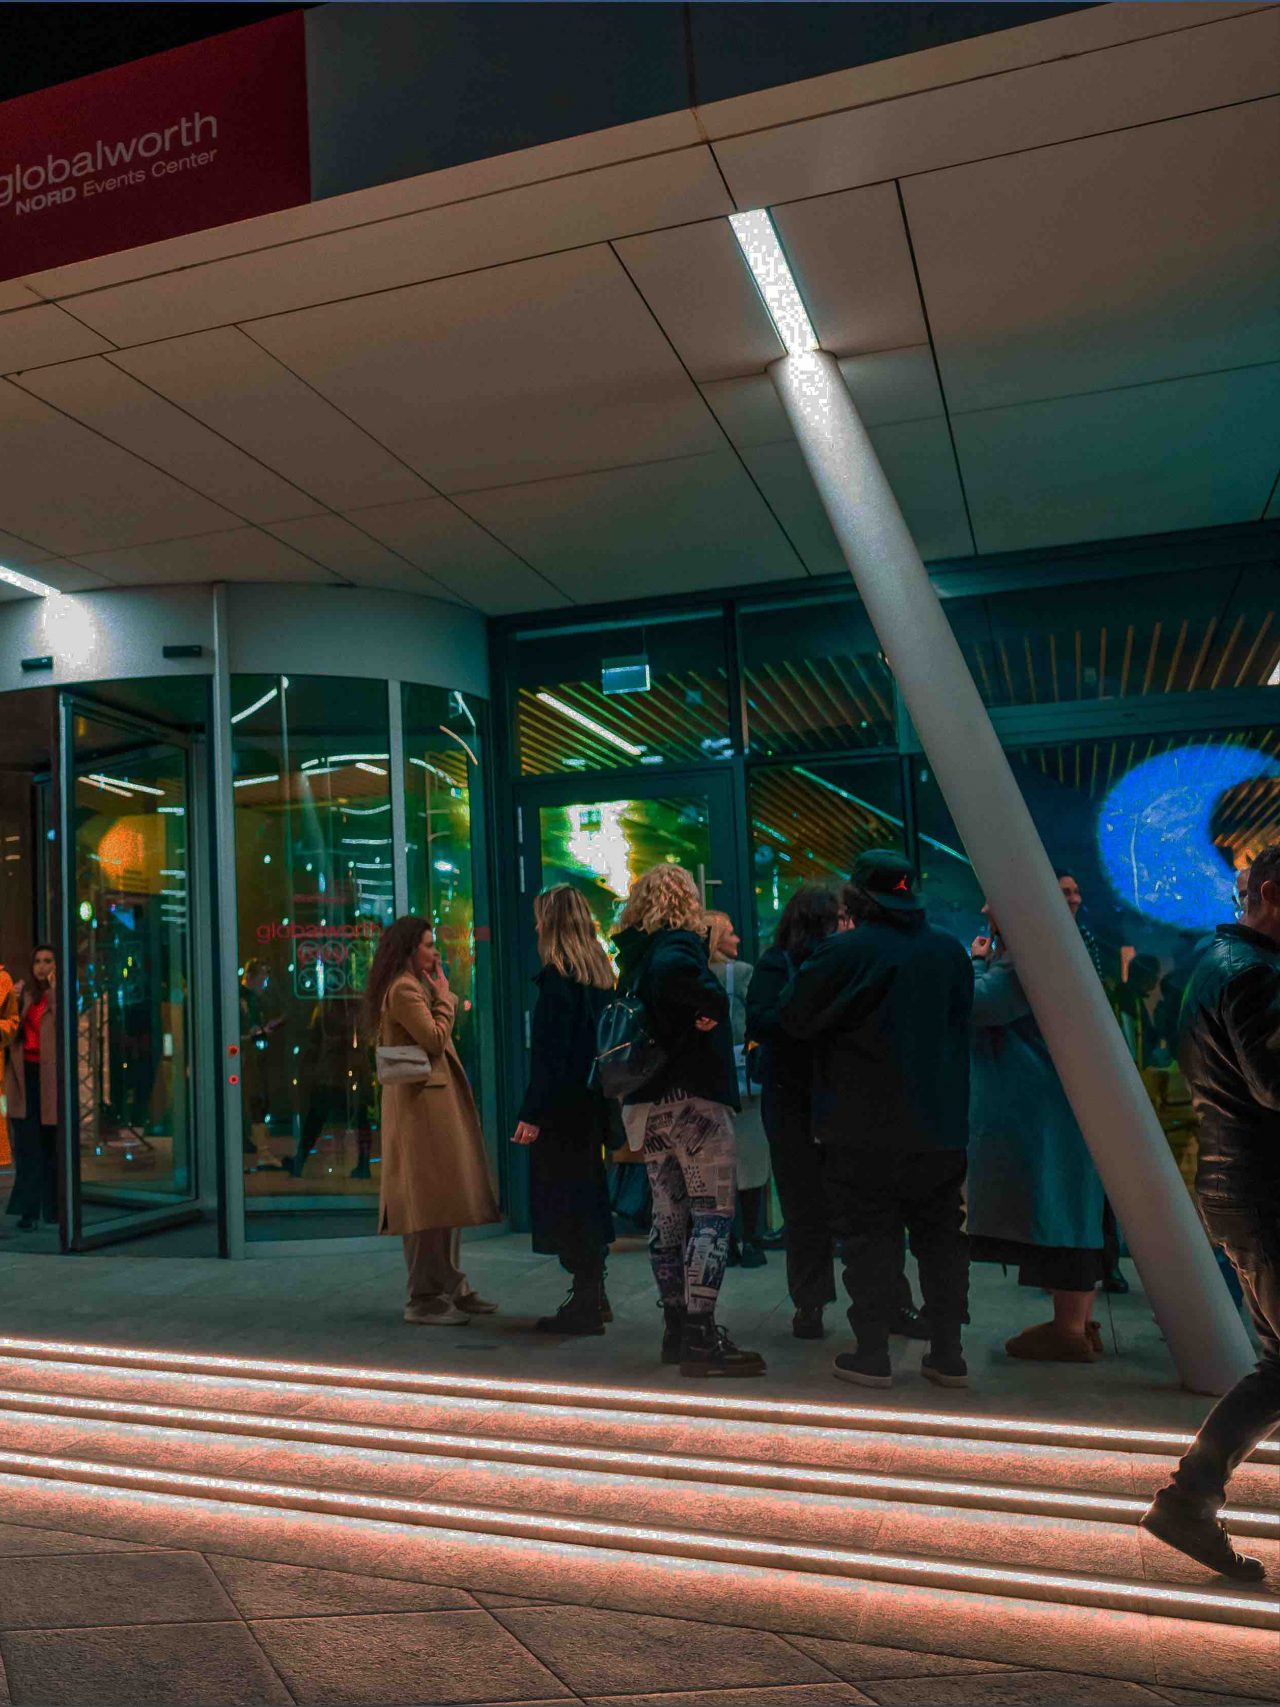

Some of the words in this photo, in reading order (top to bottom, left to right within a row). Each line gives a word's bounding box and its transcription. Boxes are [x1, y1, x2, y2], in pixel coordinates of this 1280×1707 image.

[15, 186, 76, 215] NORD
[83, 170, 146, 198] Events
[151, 149, 218, 178] Center
